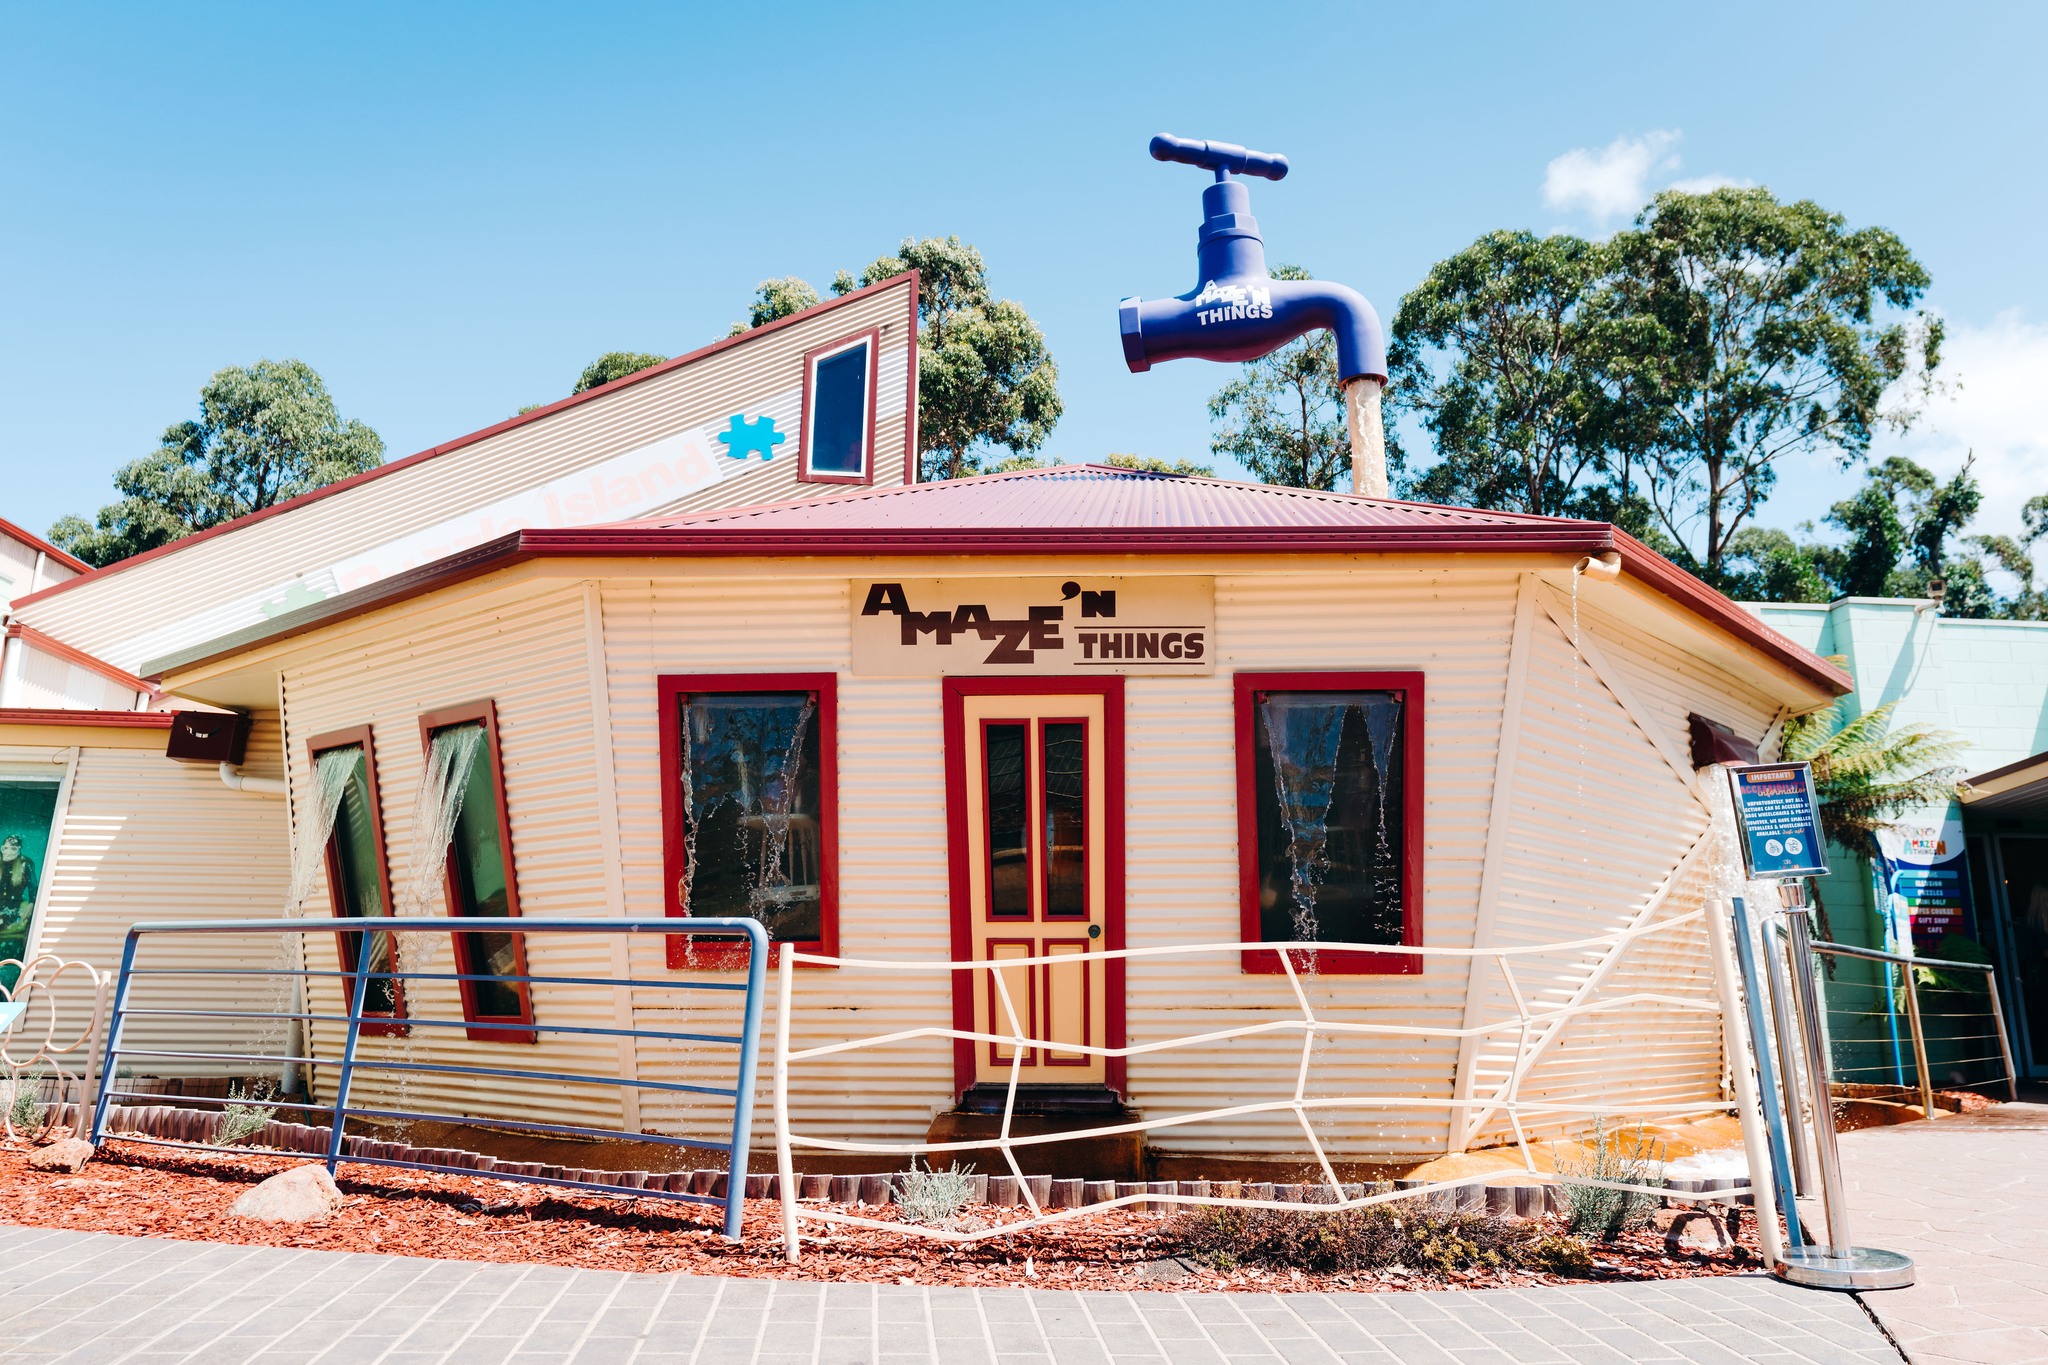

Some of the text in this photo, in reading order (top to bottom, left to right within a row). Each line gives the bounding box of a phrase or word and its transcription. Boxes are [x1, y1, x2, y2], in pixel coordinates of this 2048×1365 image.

[1197, 304, 1273, 325] THINGS
[544, 442, 713, 529] Island
[861, 581, 1116, 664] AMAZE'N
[1078, 632, 1205, 659] THINGS
[1751, 771, 1791, 781] IMPORTANT!
[1758, 810, 1790, 818] WHEELCHAIRS
[1749, 824, 1773, 832] STROLLERS
[1779, 821, 1812, 829] WHEELCHAIRS
